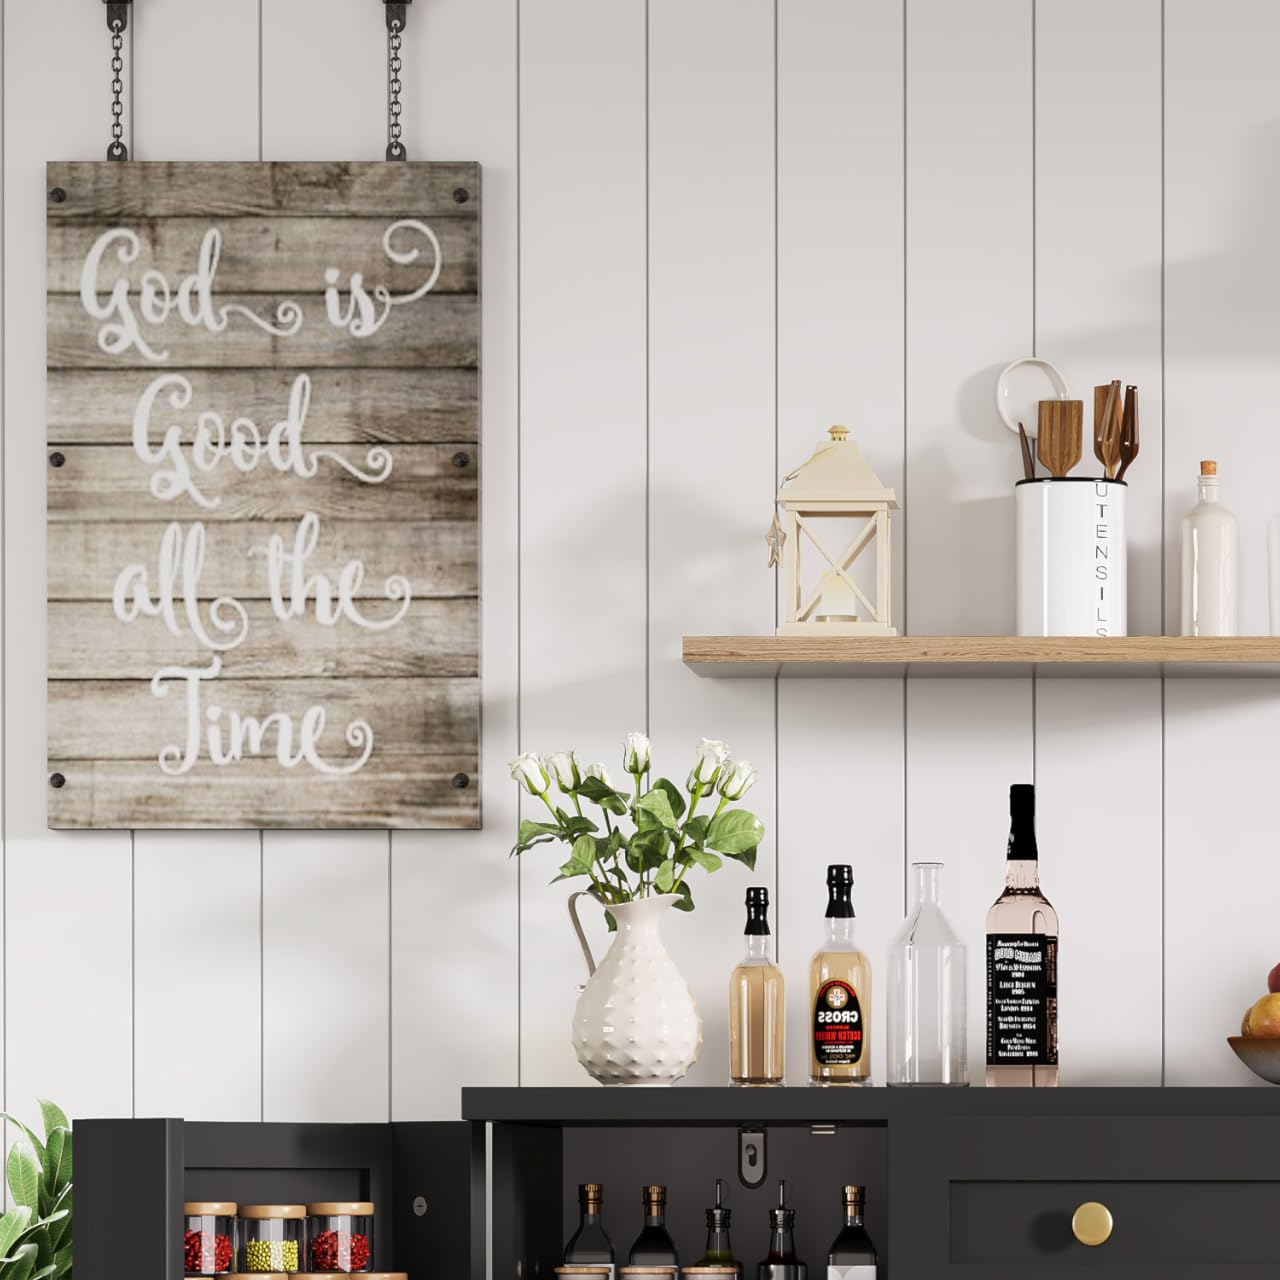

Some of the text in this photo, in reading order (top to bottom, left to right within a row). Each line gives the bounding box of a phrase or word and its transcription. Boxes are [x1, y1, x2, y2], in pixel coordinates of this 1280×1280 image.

[80, 219, 443, 360] God is
[132, 373, 393, 507] Good
[112, 511, 412, 651] all the
[151, 656, 374, 776] Time
